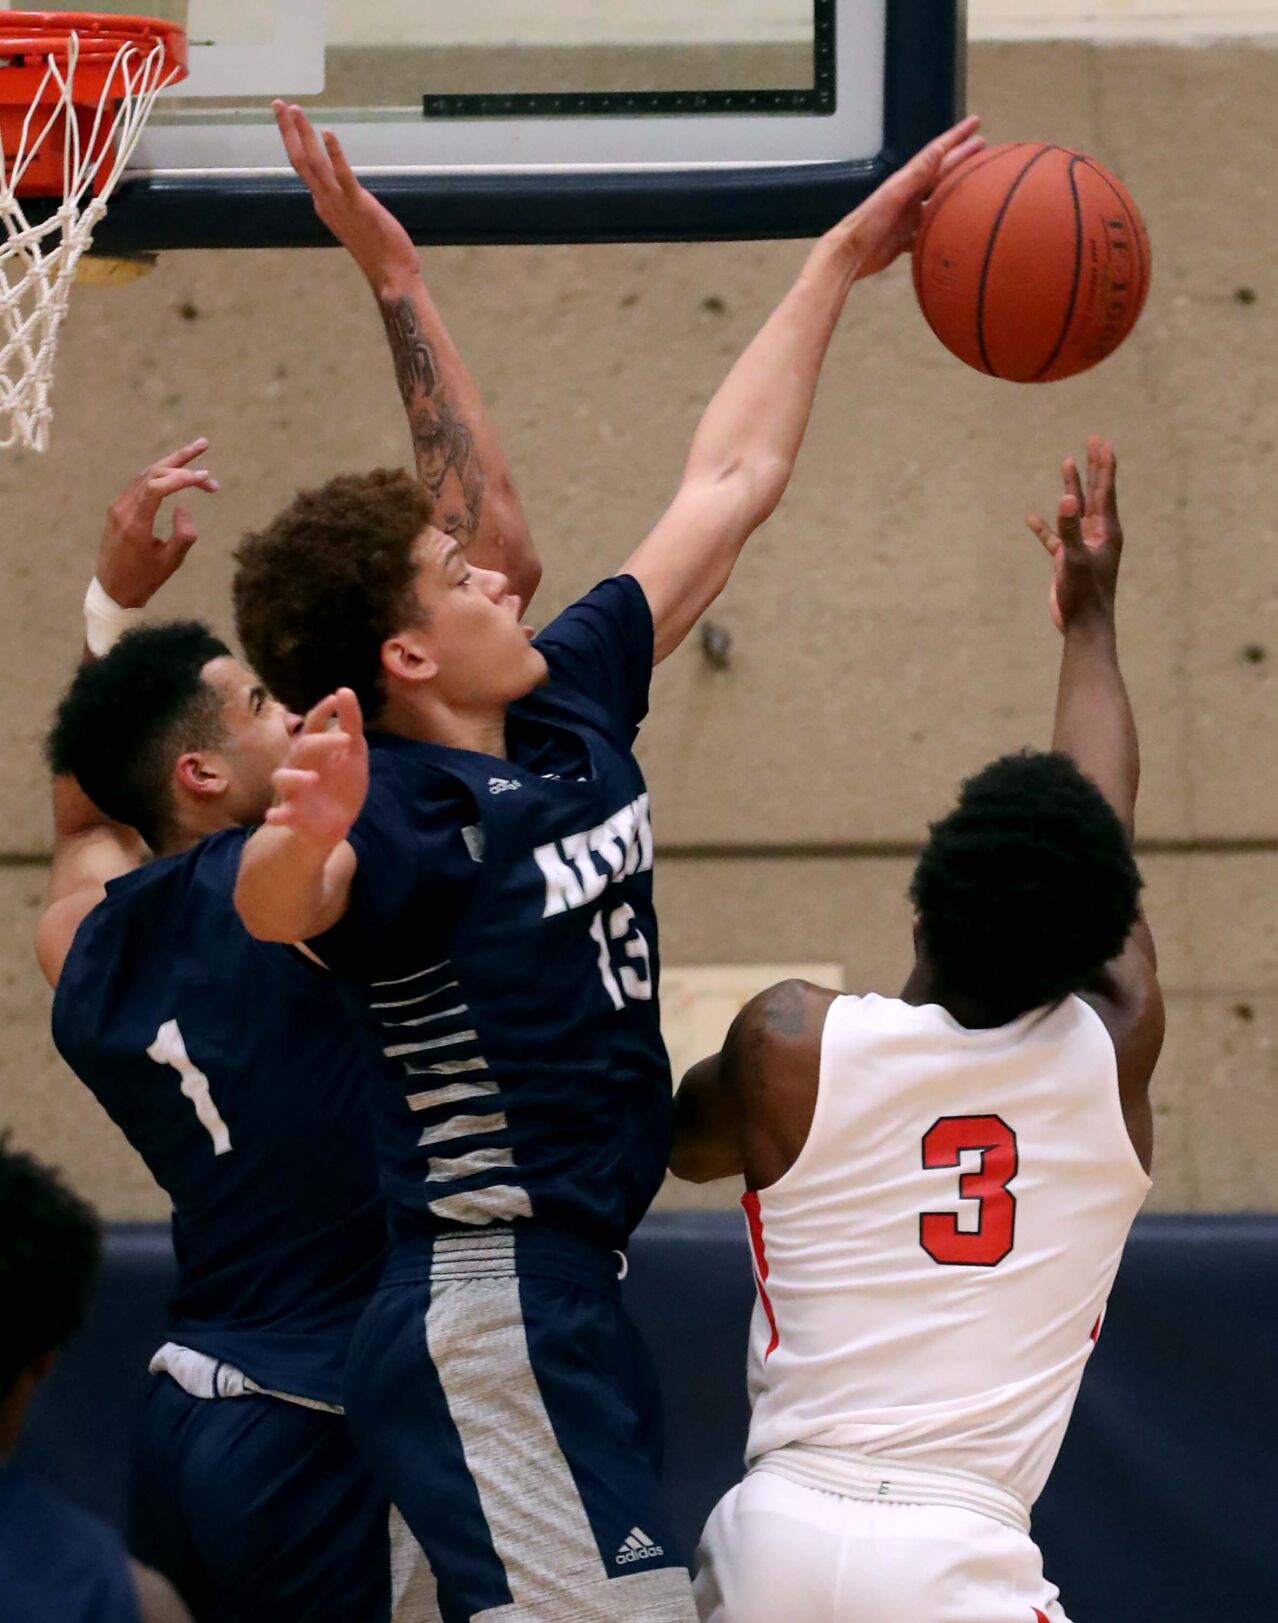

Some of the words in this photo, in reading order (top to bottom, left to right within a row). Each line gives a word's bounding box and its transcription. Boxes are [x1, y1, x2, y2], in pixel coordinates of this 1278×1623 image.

[589, 901, 653, 1011] 13
[145, 1018, 233, 1156] 1
[919, 1113, 1019, 1267] 3
[615, 1545, 664, 1565] adidas
